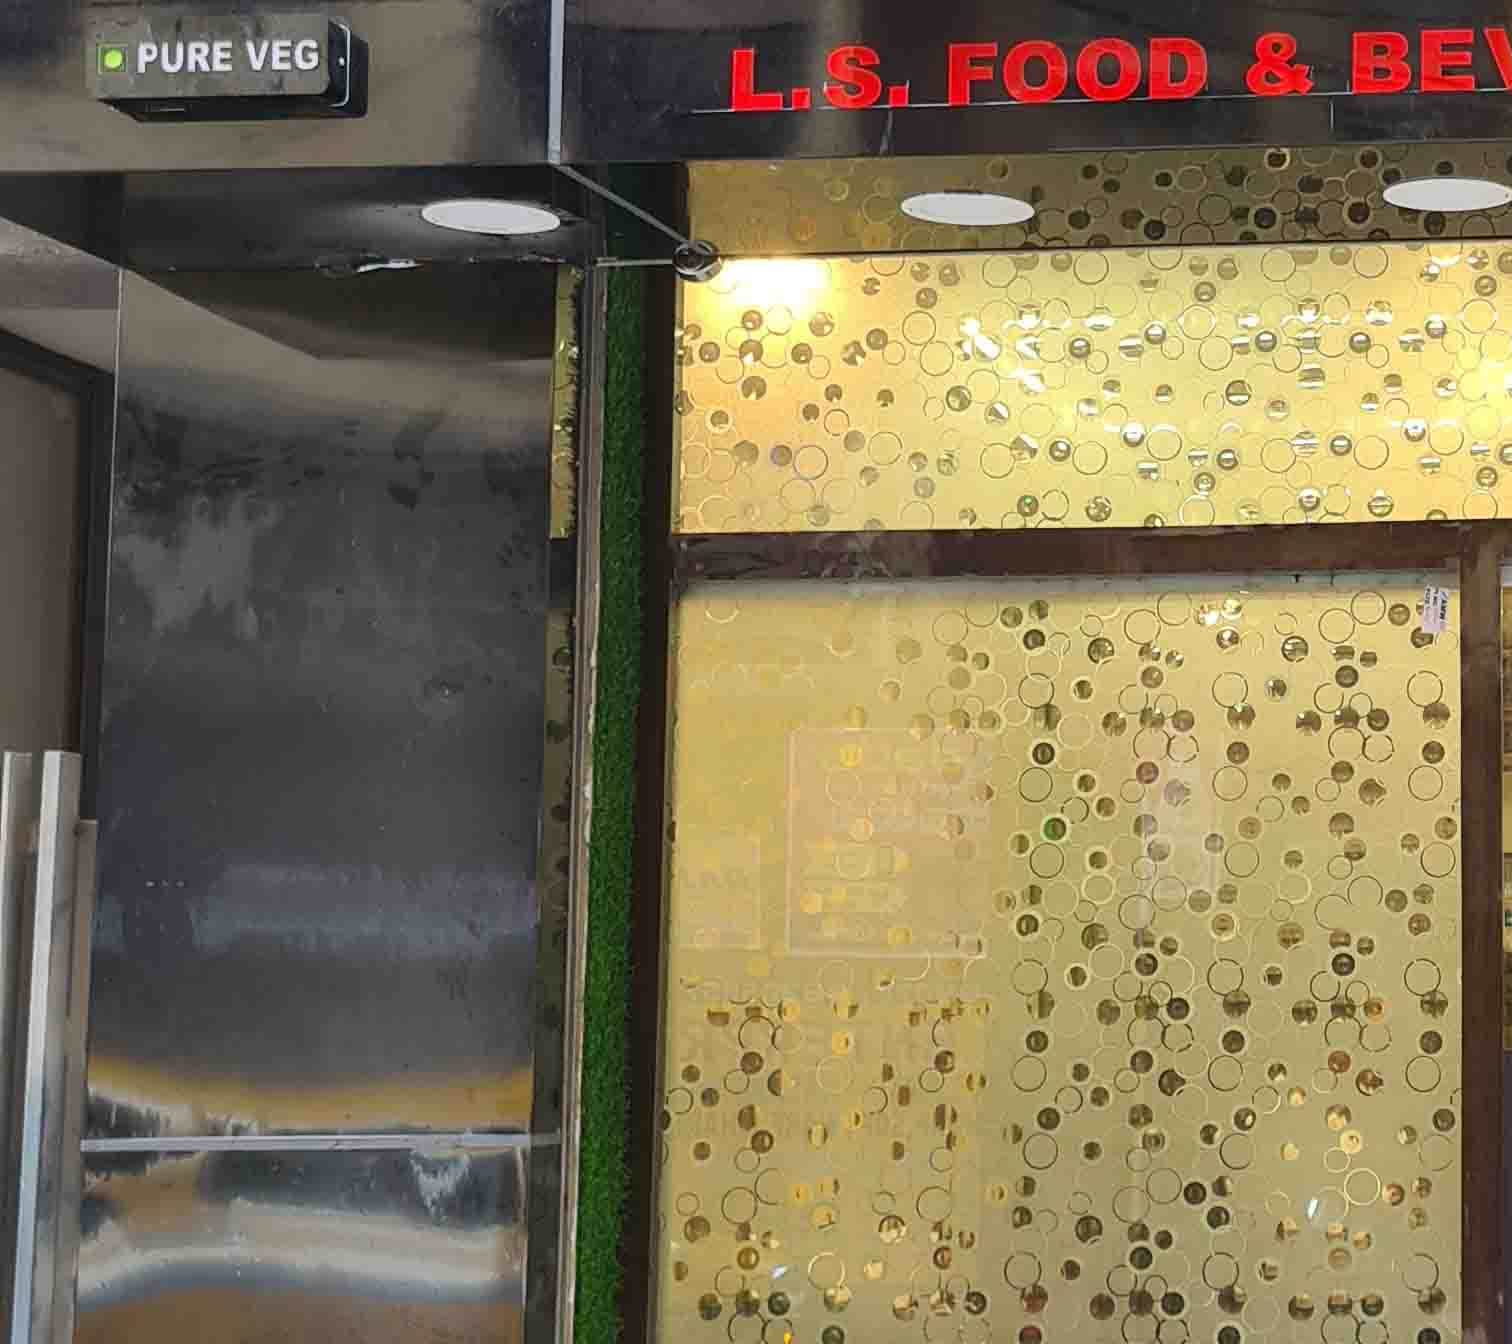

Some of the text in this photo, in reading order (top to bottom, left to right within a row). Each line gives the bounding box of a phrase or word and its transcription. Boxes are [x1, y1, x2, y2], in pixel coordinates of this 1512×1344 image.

[136, 38, 320, 73] PURE VEG
[731, 43, 908, 112] L.S.
[948, 38, 1207, 106] FOOD
[1246, 32, 1312, 96] &
